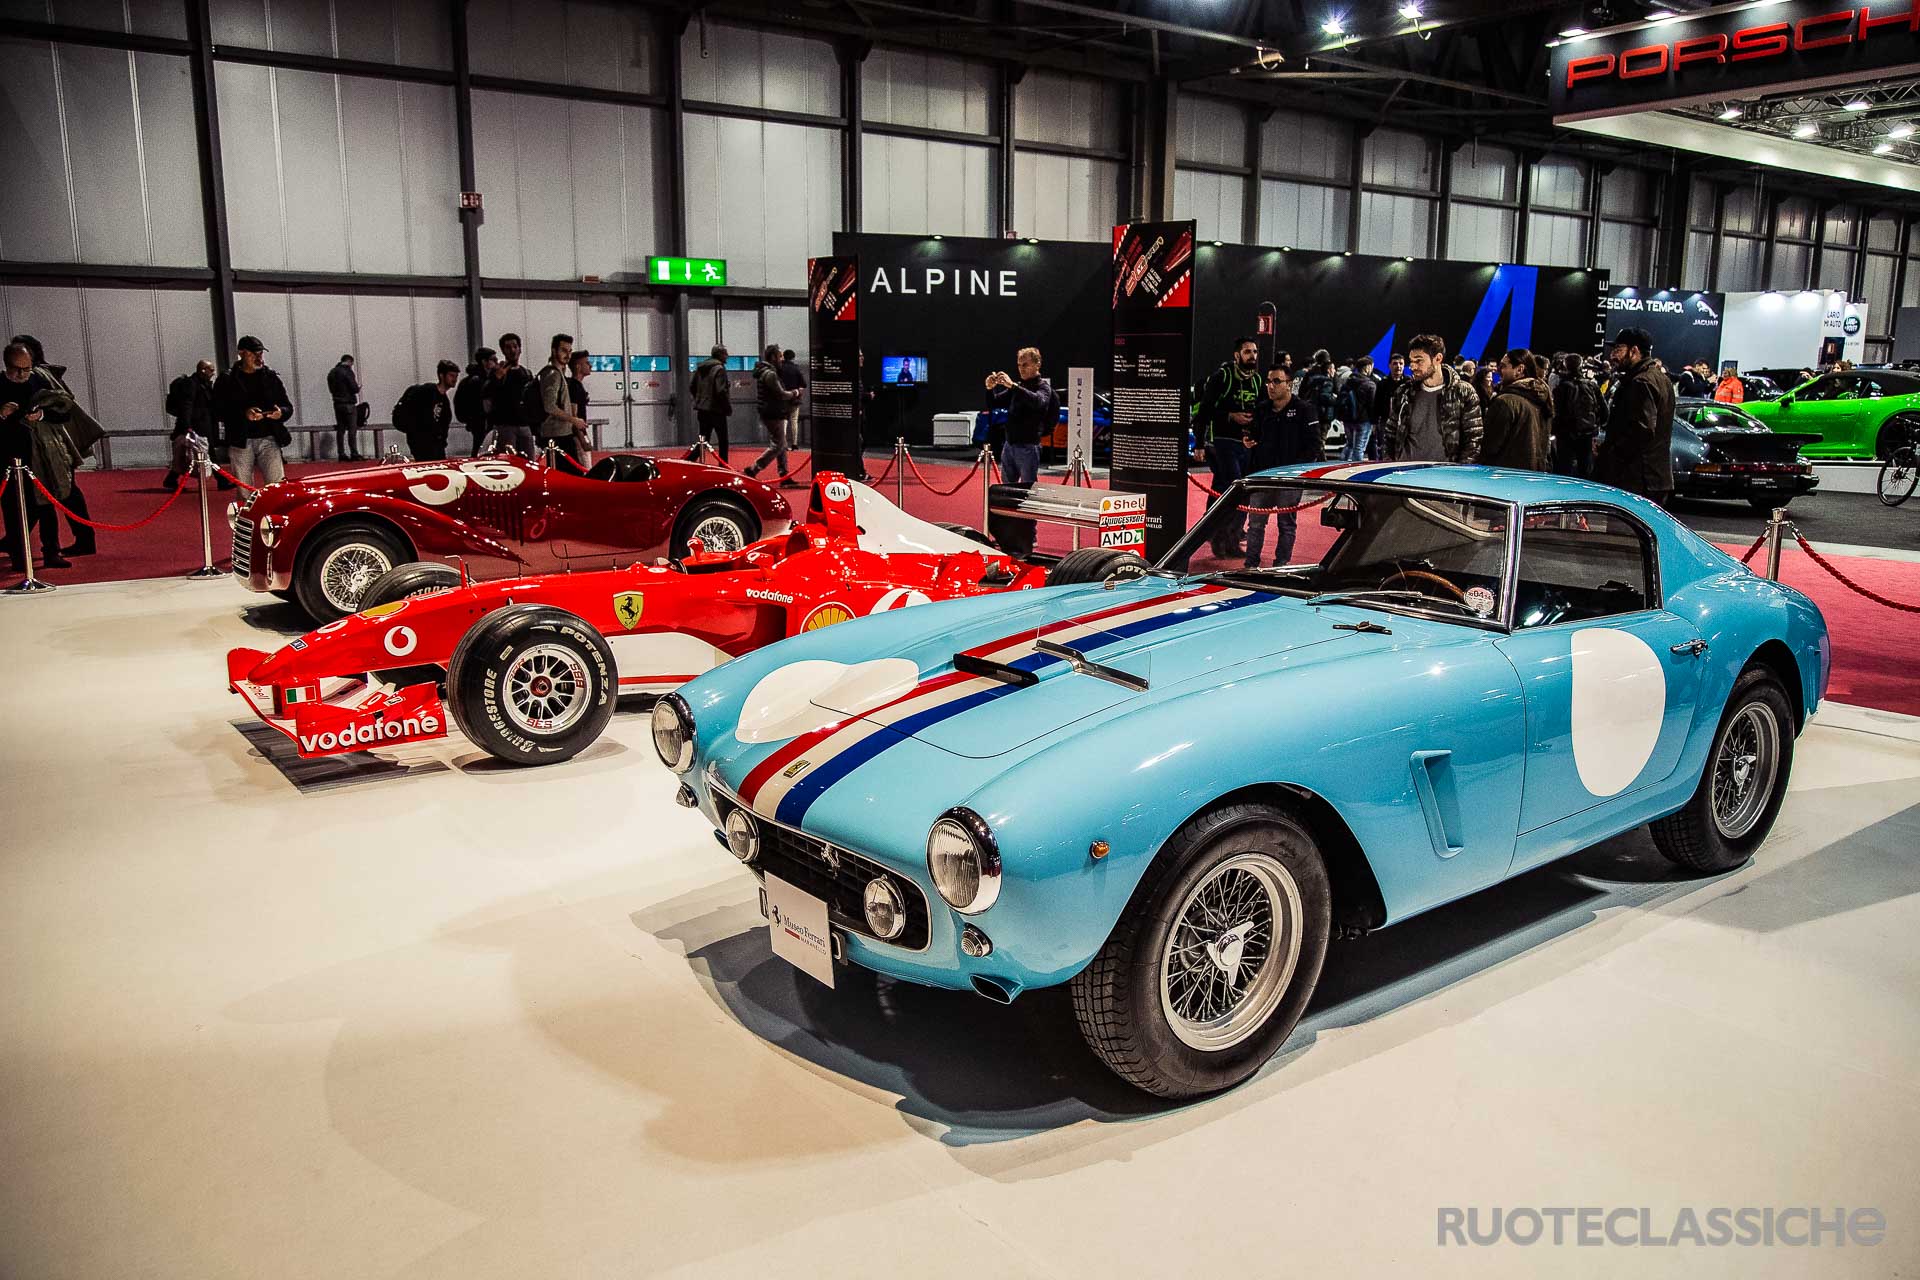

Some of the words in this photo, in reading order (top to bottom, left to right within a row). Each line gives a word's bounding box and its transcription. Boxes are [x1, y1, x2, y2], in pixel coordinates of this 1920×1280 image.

[1567, 0, 1920, 89] PORSCH
[870, 267, 1017, 296] ALPINE
[1593, 280, 1609, 364] ALPINE
[1606, 298, 1643, 311] SENZA
[1646, 300, 1684, 314] TEMPO.
[402, 460, 525, 506] 56
[1114, 497, 1145, 510] Shell
[1102, 531, 1133, 547] AMD
[746, 588, 793, 604] vodafone
[560, 626, 608, 706] POTENZA
[483, 668, 536, 753] BRIDGESTONE
[299, 715, 439, 752] vodafone
[784, 915, 804, 936] Museo
[804, 926, 826, 947] Ferrari
